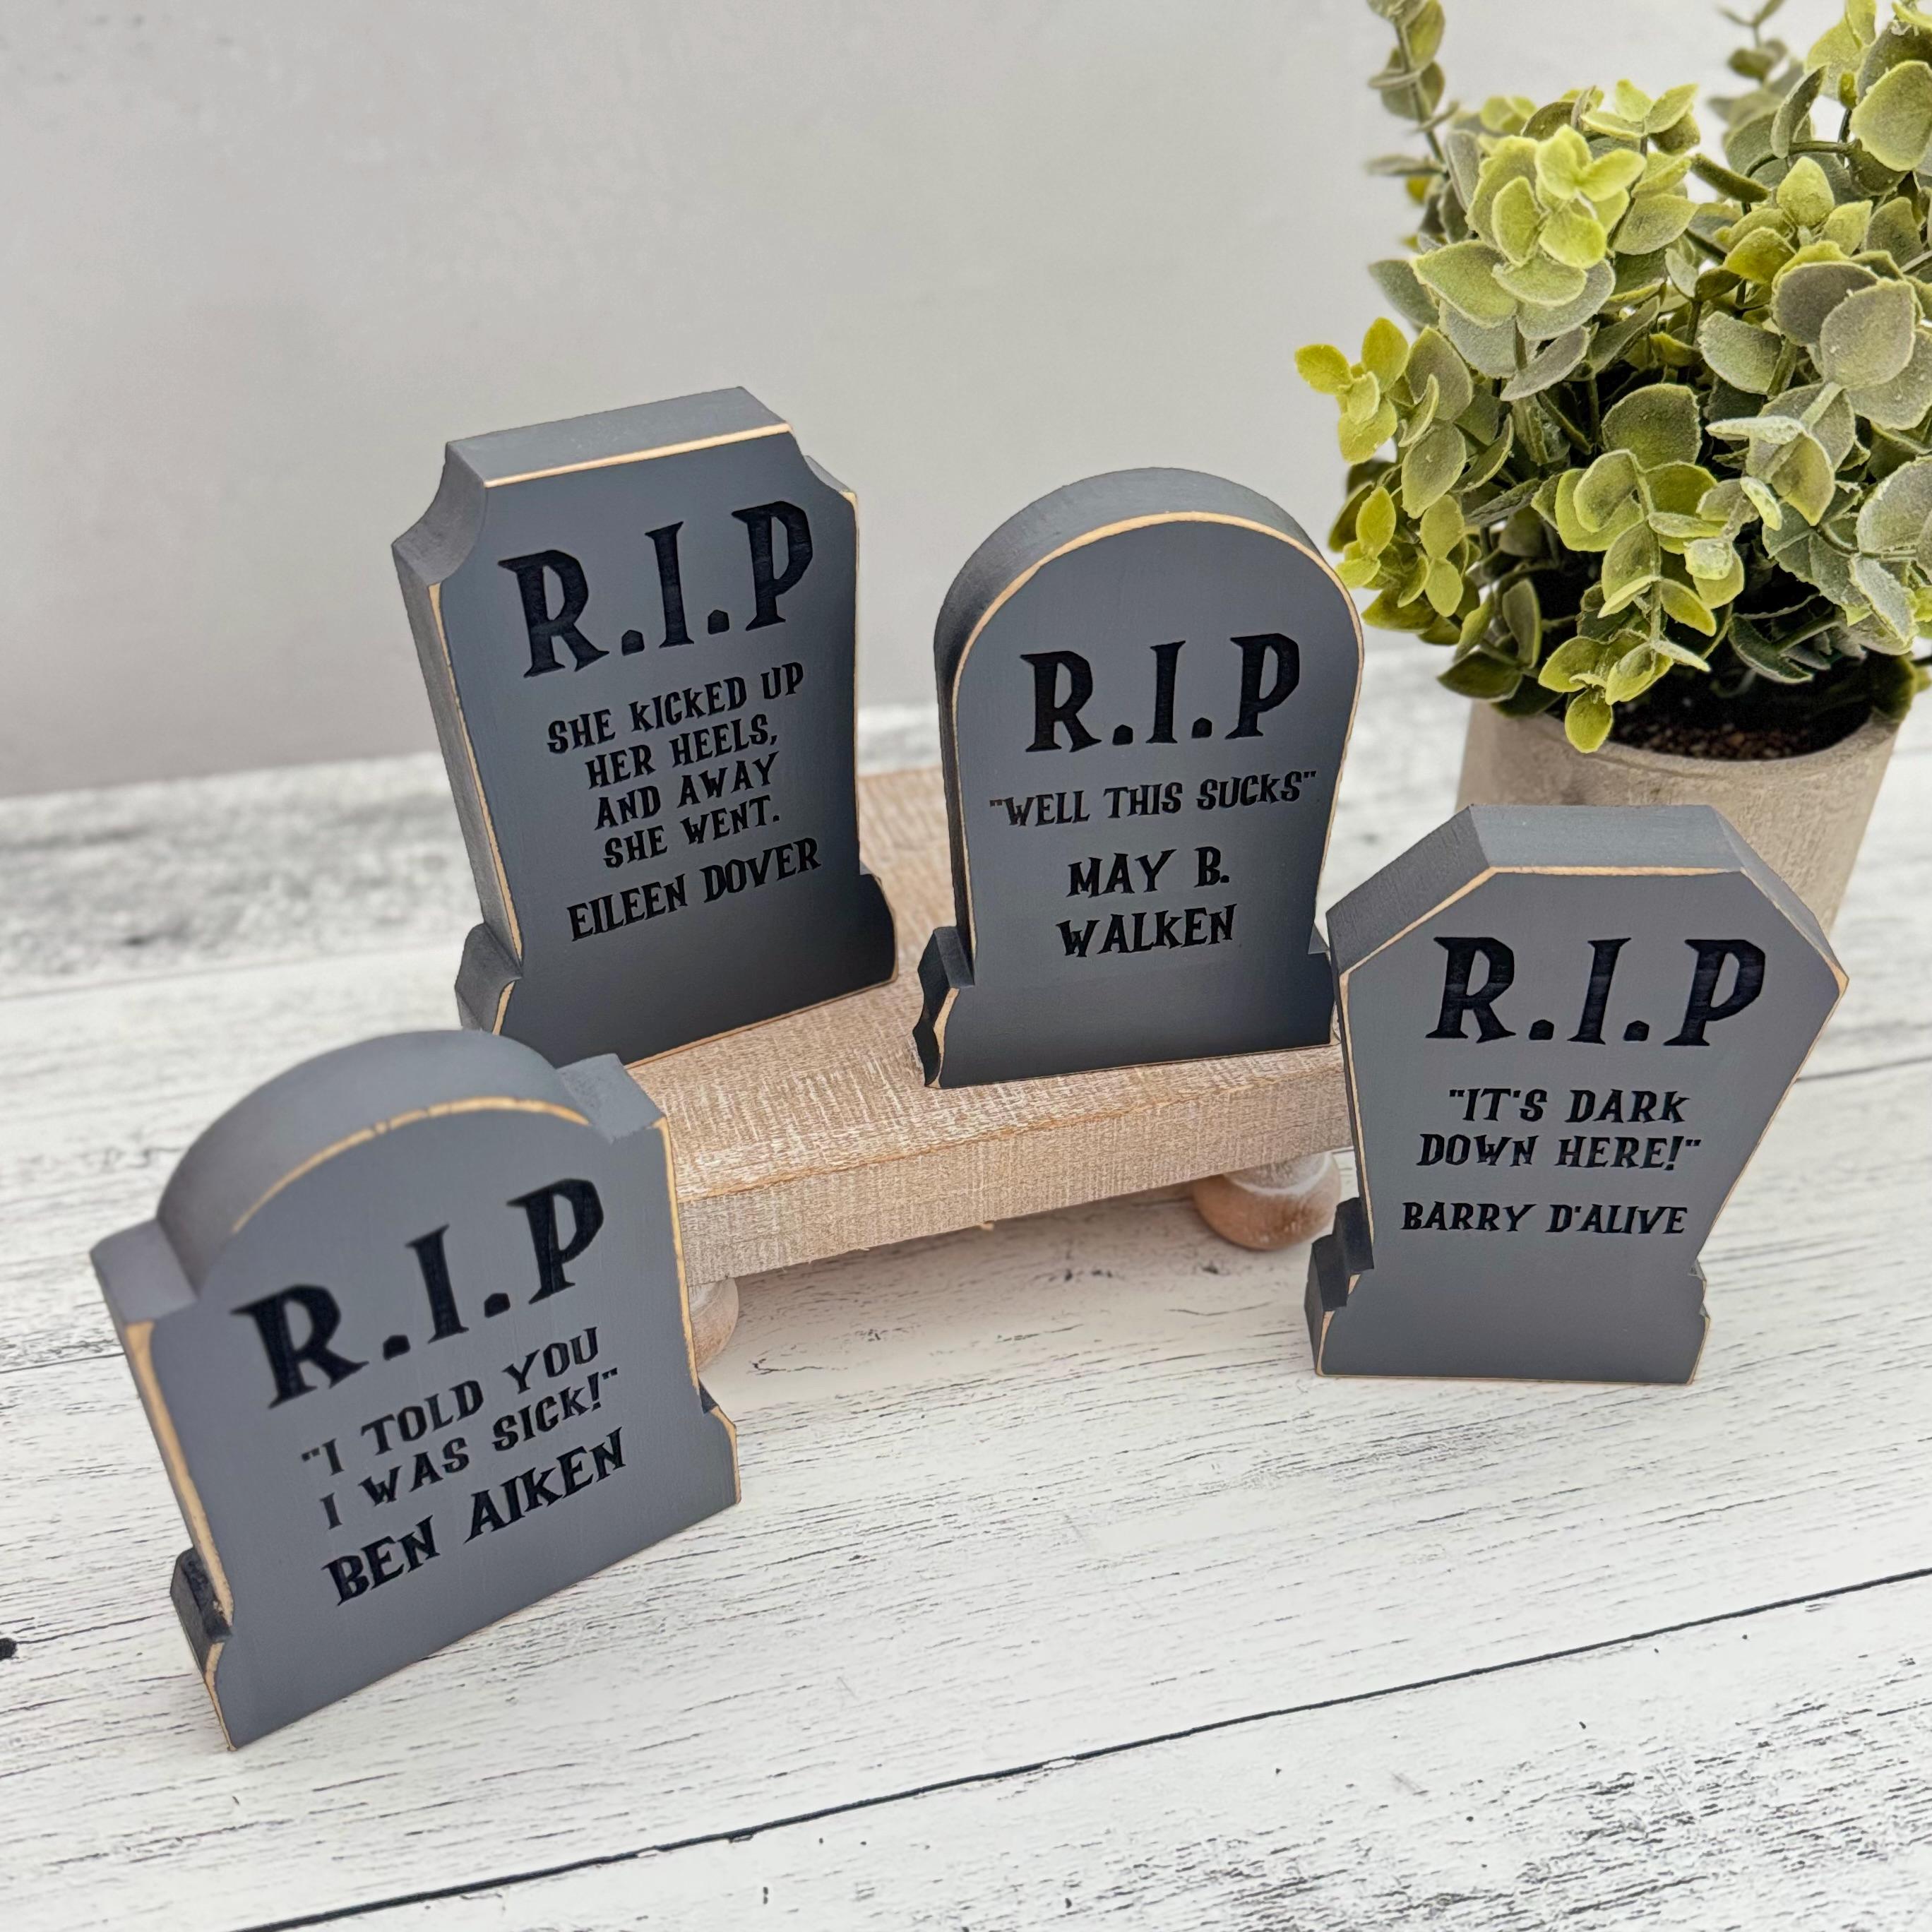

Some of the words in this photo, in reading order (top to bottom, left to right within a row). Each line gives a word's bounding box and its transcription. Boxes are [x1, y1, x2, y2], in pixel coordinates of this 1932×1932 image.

[498, 501, 813, 678] R.I.P
[547, 709, 615, 753] SHE
[628, 677, 746, 732] KICKED
[761, 662, 803, 699] UP
[1020, 633, 1299, 752] R.I.P
[585, 745, 656, 789] HER
[669, 714, 777, 768] HEELS,
[595, 786, 660, 830] AND
[677, 751, 779, 808] AWAY
[603, 825, 667, 868] SHE
[680, 795, 780, 845] WENT.
[990, 791, 1090, 826] "WELL
[1104, 782, 1183, 818] THIS
[1196, 770, 1316, 810] SUCKS"
[567, 873, 687, 941] EILEEN
[700, 837, 821, 903] DOVER
[1066, 849, 1176, 898] MAY
[1194, 847, 1229, 888] B.
[1056, 904, 1237, 957] WALKEN
[1426, 937, 1765, 1046] R.I.P
[1450, 1088, 1547, 1122] "IT'S
[1565, 1089, 1689, 1123] DARK
[1417, 1134, 1539, 1167] DOWN
[1555, 1135, 1701, 1171] HERE!"
[1401, 1201, 1537, 1232] BARRY
[1546, 1204, 1687, 1234] D'ALIVE
[232, 1179, 604, 1408] R.I.P
[302, 1439, 343, 1475] "I
[362, 1381, 483, 1455] TOLD
[503, 1327, 598, 1394] YOU
[321, 1493, 341, 1529] I
[359, 1438, 469, 1506] WAS
[492, 1368, 617, 1451] SICK!"
[322, 1515, 440, 1606] BEN
[465, 1427, 626, 1543] AIKEN
